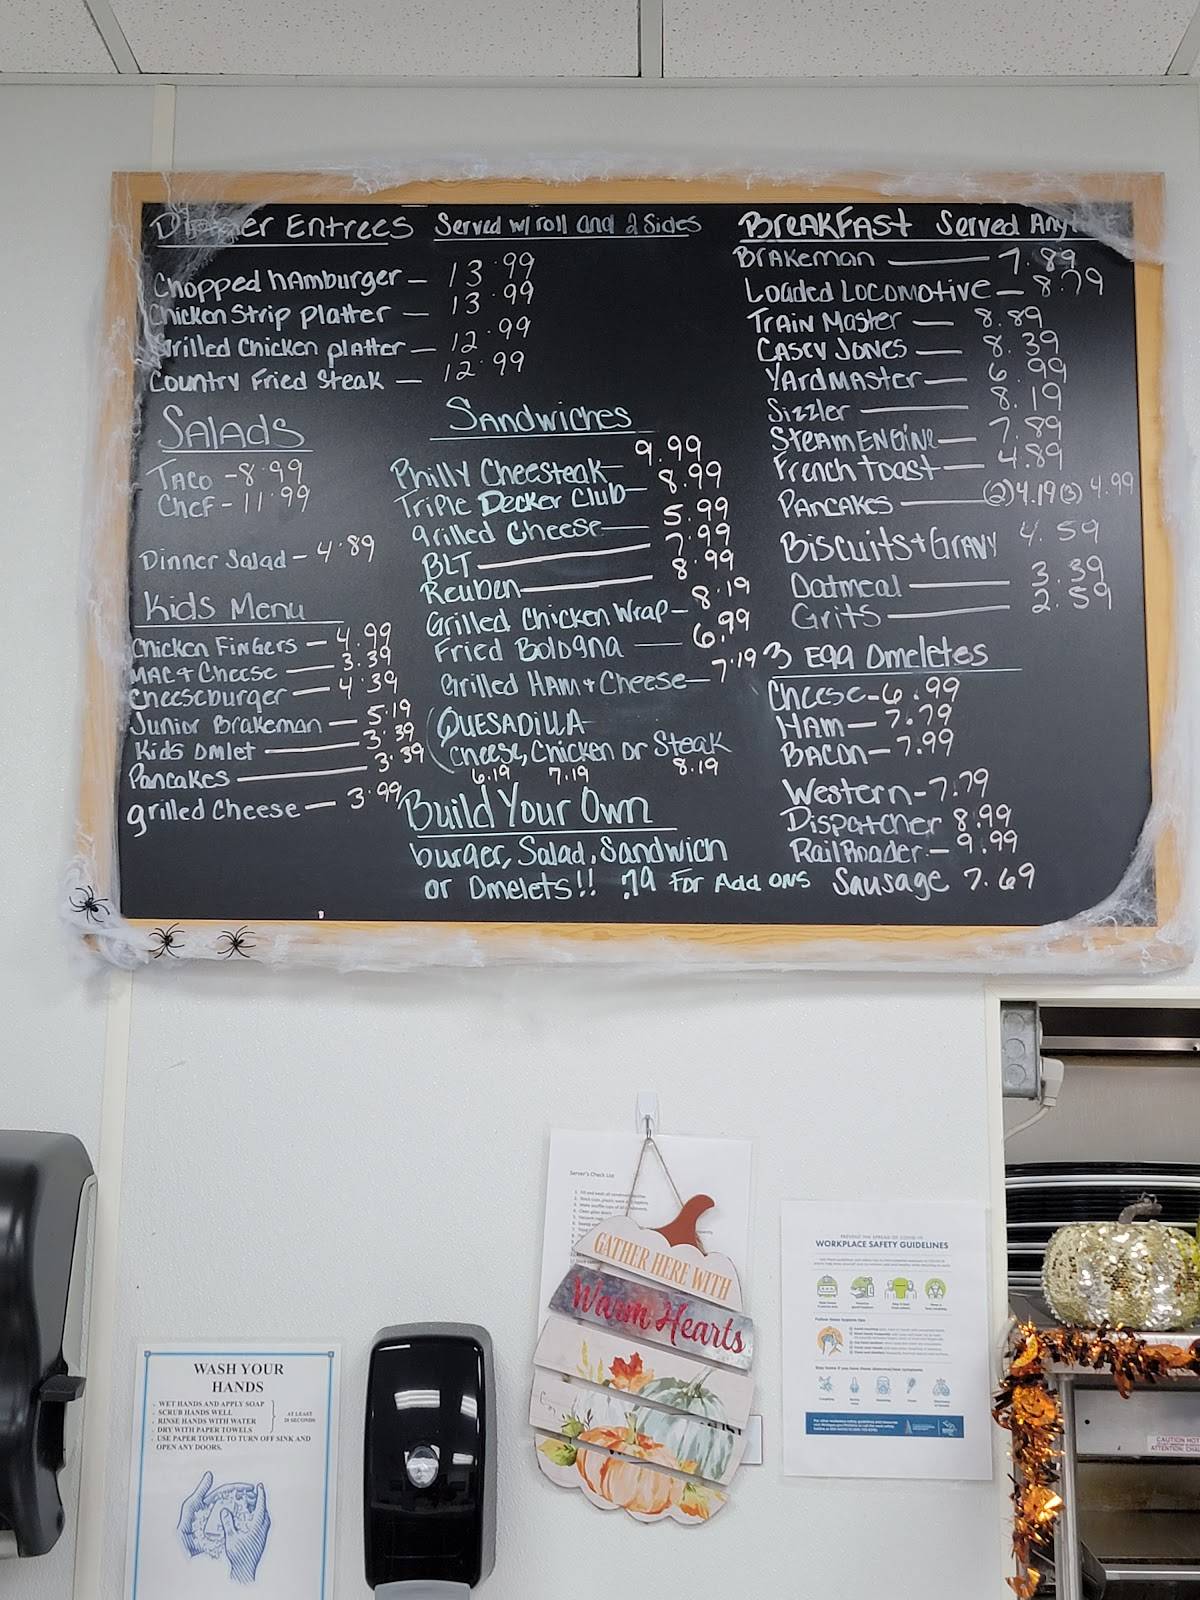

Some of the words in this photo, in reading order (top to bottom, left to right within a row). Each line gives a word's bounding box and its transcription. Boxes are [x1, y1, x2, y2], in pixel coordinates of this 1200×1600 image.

[434, 212, 501, 236] Served
[576, 214, 615, 235] and
[625, 213, 639, 235] 2
[643, 212, 702, 234] Sides
[936, 209, 1020, 237] Served
[153, 268, 262, 302] Chopped
[449, 251, 535, 288] 13.99
[998, 246, 1076, 275] 7.89
[745, 277, 834, 304] Loaded
[1032, 269, 1104, 297] 8.79
[230, 303, 292, 332] Strip
[452, 280, 534, 315] 13.99
[974, 305, 1043, 329] 8.89
[238, 336, 318, 358] Chicken
[451, 316, 531, 353] 12.99
[983, 330, 1060, 358] 8.39
[150, 368, 239, 393] Country
[251, 367, 307, 391] Fried
[317, 368, 384, 391] Steak
[444, 350, 525, 383] 12.99
[988, 357, 1067, 385] 6.99
[767, 397, 851, 423] Sizzler
[990, 382, 1062, 411] 8.19
[989, 416, 1062, 444] 7.89
[390, 457, 470, 490] Philly
[480, 457, 608, 487] Cheesteak
[635, 434, 702, 467] 9.99
[773, 452, 855, 483] French
[997, 442, 1063, 471] 4.89
[244, 484, 311, 515] 11.99
[393, 489, 472, 519] Triple
[478, 489, 562, 516] Decker
[571, 482, 627, 507] Club
[658, 460, 722, 494] 8.99
[1090, 472, 1134, 497] 4.99
[507, 518, 603, 546] Cheese
[663, 497, 729, 527] 5.99
[1019, 518, 1099, 547] 4.59
[139, 549, 218, 571] Dinner
[225, 549, 287, 571] Salad
[317, 534, 375, 563] 4.89
[422, 550, 473, 583] BLT
[665, 522, 731, 557] 7.99
[1031, 554, 1105, 588] 3.39
[420, 578, 522, 605] Reuben
[671, 548, 735, 581] 8.99
[144, 591, 216, 622] Kids
[231, 592, 306, 622] Menu
[426, 609, 511, 639] Grilled
[522, 604, 610, 631] Chicken
[613, 598, 670, 624] Wrap
[691, 576, 750, 609] 8.19
[791, 603, 881, 631] Grits
[1031, 581, 1112, 614] 2.59
[131, 636, 209, 660] Chicken
[336, 621, 392, 652] 4.99
[434, 638, 503, 664] Fried
[514, 635, 624, 662] Bologna
[692, 607, 750, 650] 6.99
[763, 641, 793, 671] 3
[866, 635, 989, 669] Omeletes
[198, 660, 278, 684] Cheese
[341, 646, 392, 672] 3.39
[600, 669, 687, 696] Cheese
[711, 647, 757, 684] 7.19
[129, 687, 288, 713] Cheeseburger
[338, 669, 398, 701] 4.39
[767, 678, 866, 713] Cheese
[882, 676, 960, 704] 6.99
[130, 711, 200, 738] Junior
[213, 714, 323, 735] Brakeman
[367, 698, 412, 726] 5.19
[885, 703, 952, 729] 7.79
[135, 741, 184, 761] Kids
[194, 740, 256, 761] Omlet
[363, 721, 415, 750] 3.39
[530, 738, 615, 764] Chicken
[621, 742, 648, 761] or
[653, 729, 732, 757] Steak
[896, 727, 954, 757] 7.99
[128, 762, 230, 790] Pancakes
[374, 742, 425, 773] 3.39
[471, 762, 512, 785] 6.19
[549, 765, 590, 786] 7.19
[672, 757, 719, 777] 8.19
[781, 777, 912, 805] Western
[928, 768, 989, 801] 7.79
[127, 798, 205, 838] grilled
[212, 798, 302, 821] Cheese
[347, 781, 402, 810] 3.99
[398, 784, 496, 831] Build
[496, 781, 572, 829] Your
[580, 786, 654, 826] Own
[780, 805, 942, 837] Dispatcher
[953, 803, 1012, 831] 8.99
[600, 836, 728, 864] Sandwich
[956, 829, 1018, 854] 9.99
[424, 877, 454, 899] or
[714, 872, 761, 893] Add
[832, 866, 950, 902] Sausage
[963, 862, 1036, 891] 7.69
[815, 1240, 867, 1249] WORKPLACE
[868, 1240, 898, 1249] SAFETY
[899, 1241, 949, 1250] GUIDELINES
[592, 1231, 650, 1271] GATHER
[651, 1251, 689, 1286] HERE
[691, 1266, 733, 1301] WITH
[571, 1273, 650, 1330] Warm
[655, 1300, 746, 1354] Hearts
[194, 1363, 236, 1375] WASH
[241, 1363, 284, 1375] YOUR
[212, 1381, 264, 1393] HANDS
